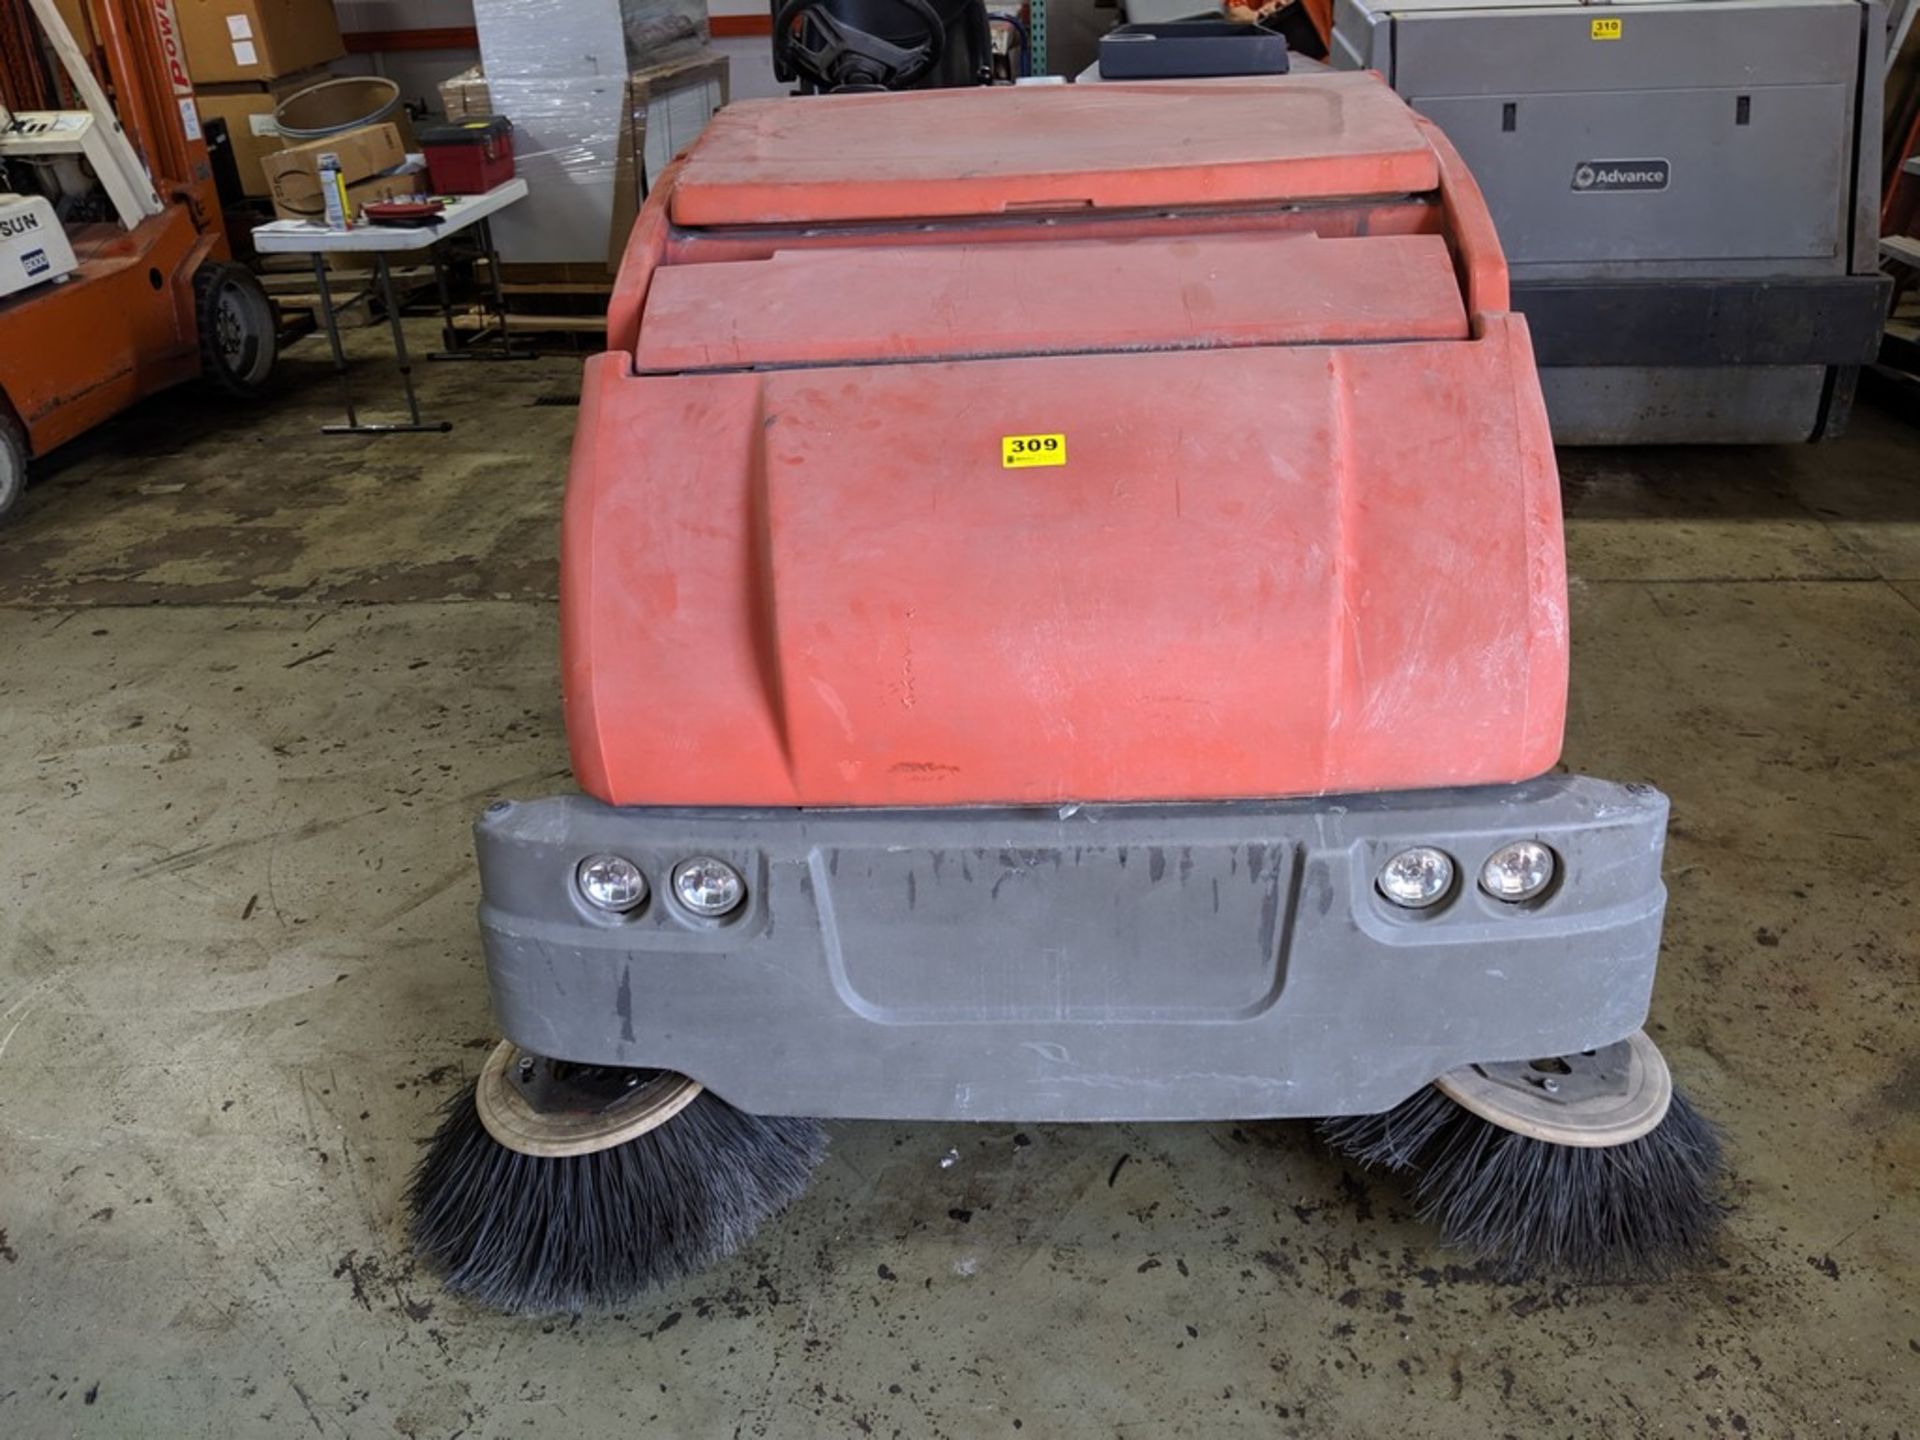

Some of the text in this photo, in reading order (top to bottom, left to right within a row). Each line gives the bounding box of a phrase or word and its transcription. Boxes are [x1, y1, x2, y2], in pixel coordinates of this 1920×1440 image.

[1595, 21, 1619, 31] 310
[1596, 168, 1665, 183] Advance
[1011, 438, 1058, 453] 309
